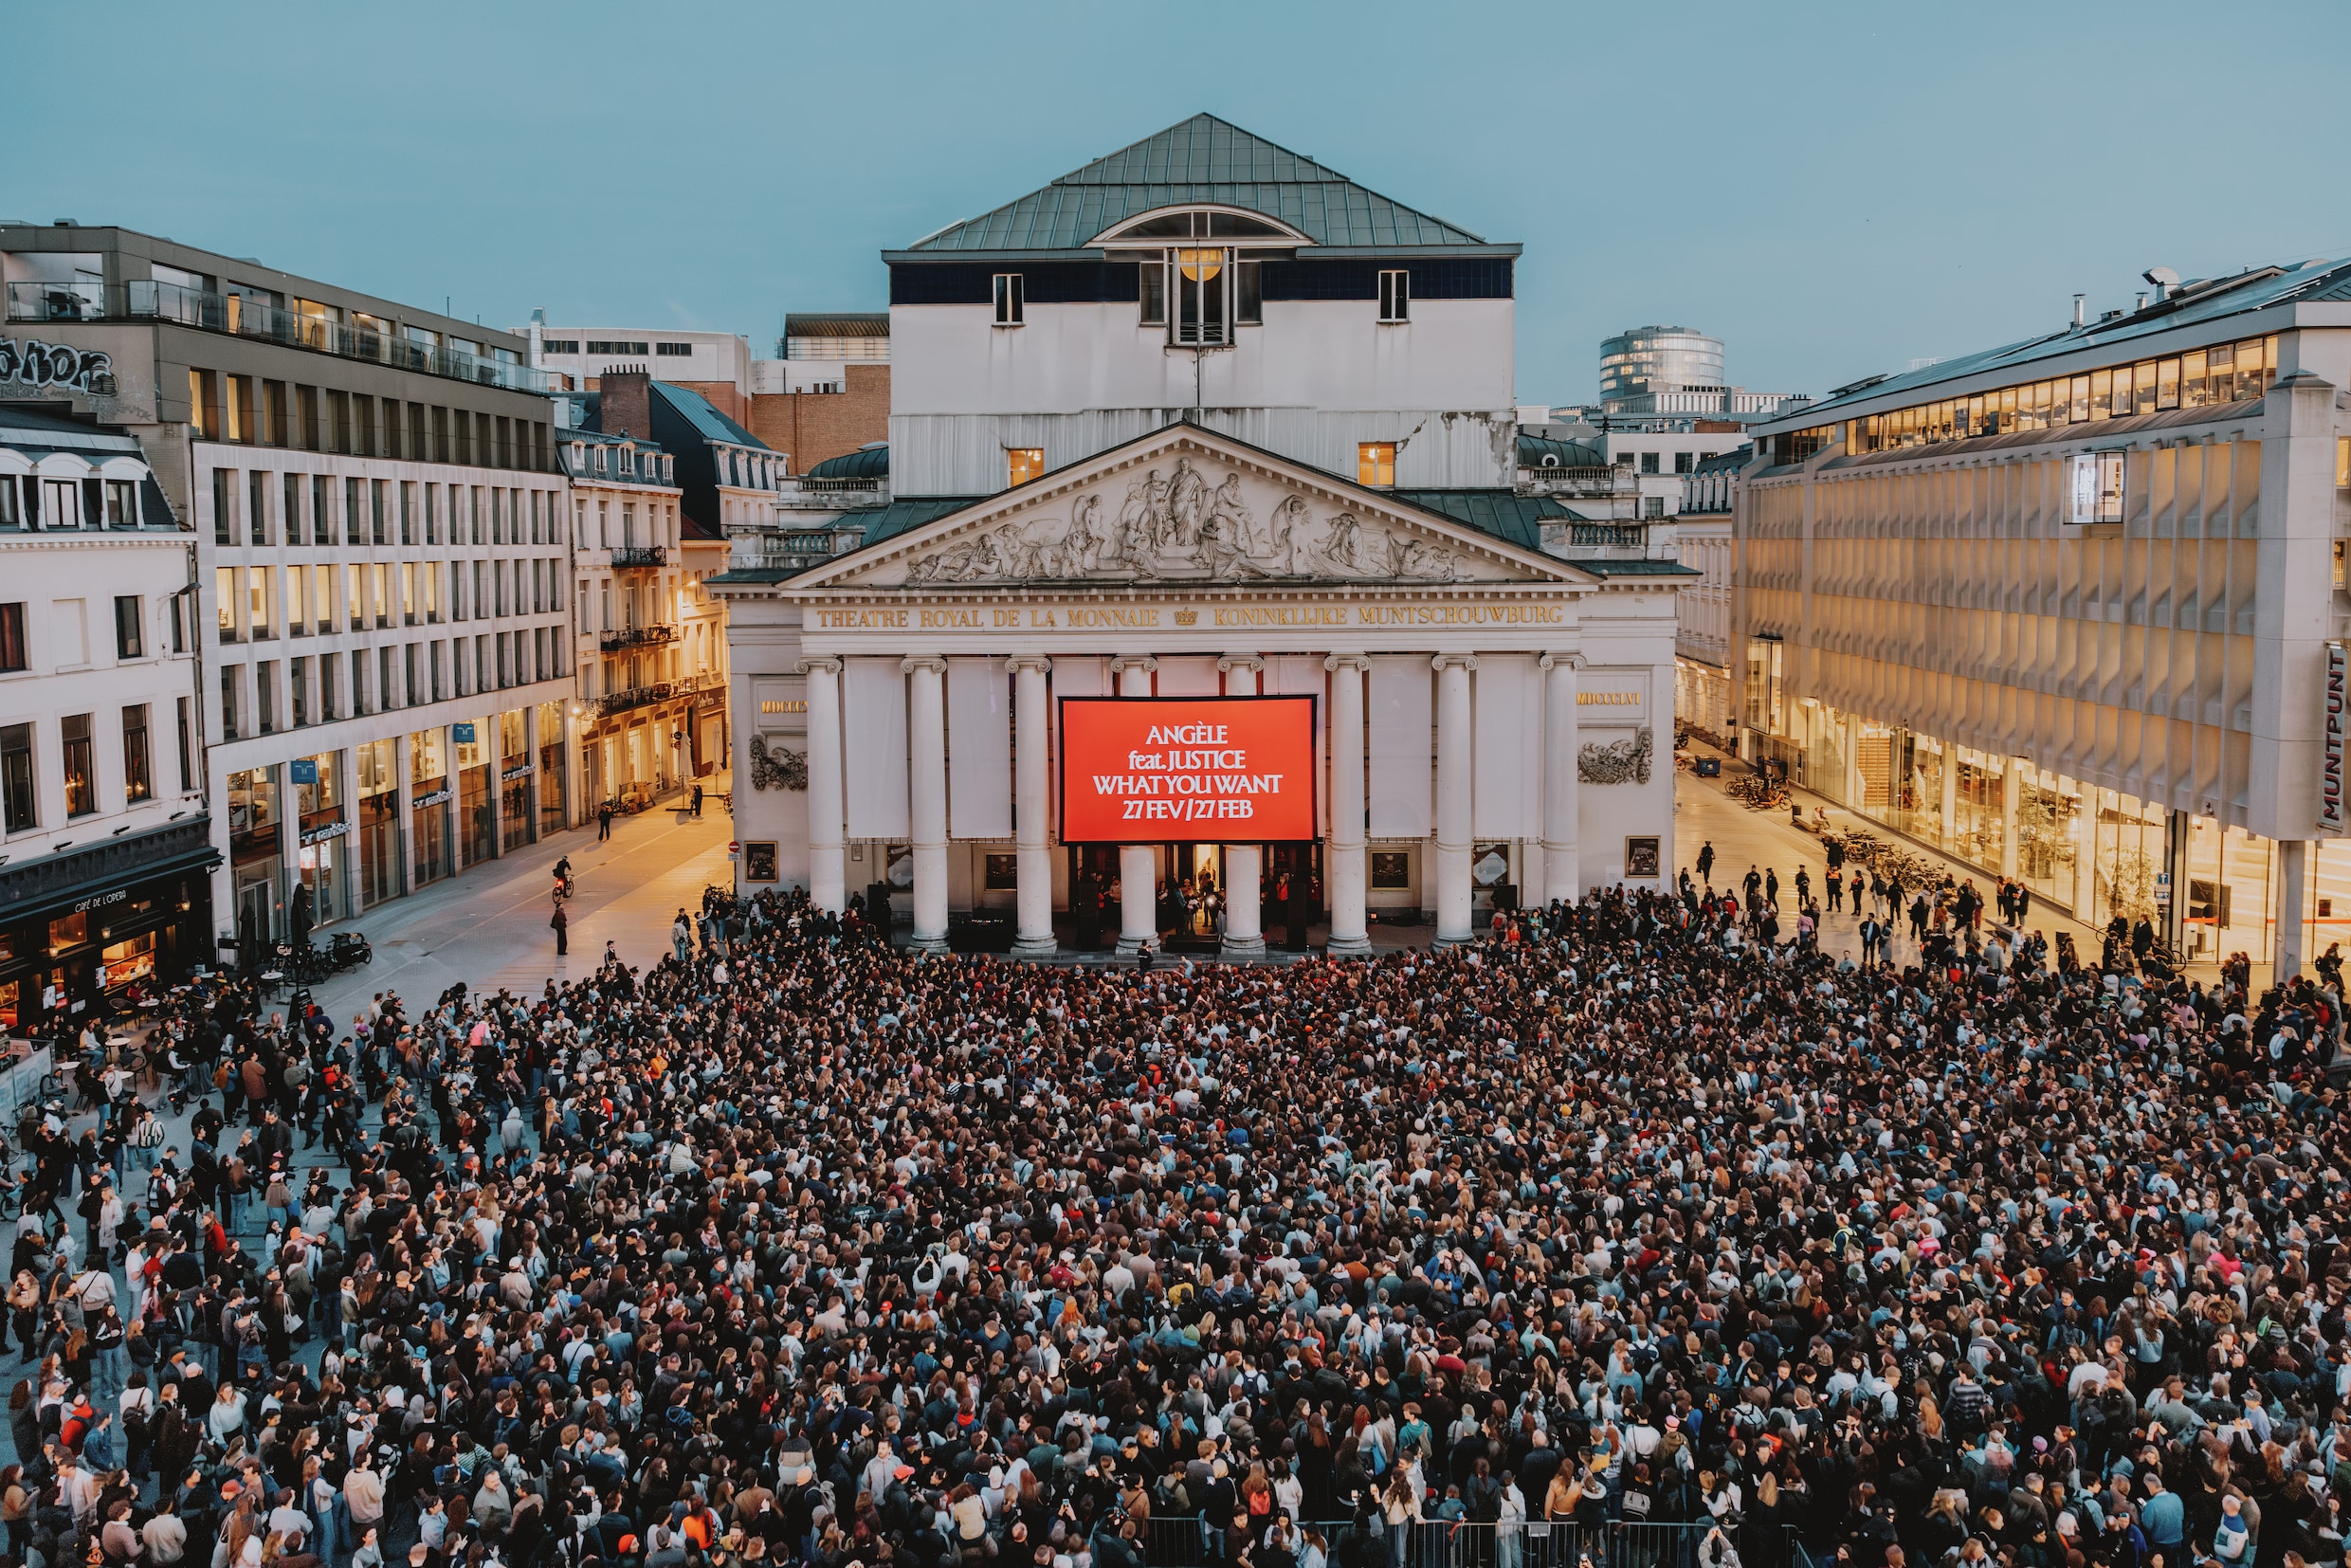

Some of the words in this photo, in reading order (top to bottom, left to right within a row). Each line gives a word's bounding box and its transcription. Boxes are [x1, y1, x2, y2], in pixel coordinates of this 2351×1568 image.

[816, 610, 909, 628] THEATRE
[920, 610, 984, 628] ROYAL
[993, 610, 1020, 628] DE
[1030, 609, 1057, 627] LA
[1066, 609, 1160, 627] MONNAIE
[1213, 607, 1348, 626] KONINKLIJKE
[1358, 606, 1563, 624] MUNTSCHOUWBURG
[1576, 692, 1641, 705] MDCCCLVI
[1145, 720, 1228, 745] ANGÈLE
[2324, 649, 2344, 821] MUNTPUNT
[1128, 750, 1167, 770] feat.
[1167, 750, 1246, 772] JUSTICE
[1092, 775, 1163, 794] WHAT
[1161, 775, 1212, 794] YOU
[1213, 775, 1284, 793] WANT
[1122, 800, 1144, 819] 27
[1217, 799, 1254, 819] FEB
[316, 818, 352, 841] randstad
[93, 898, 101, 907] DE
